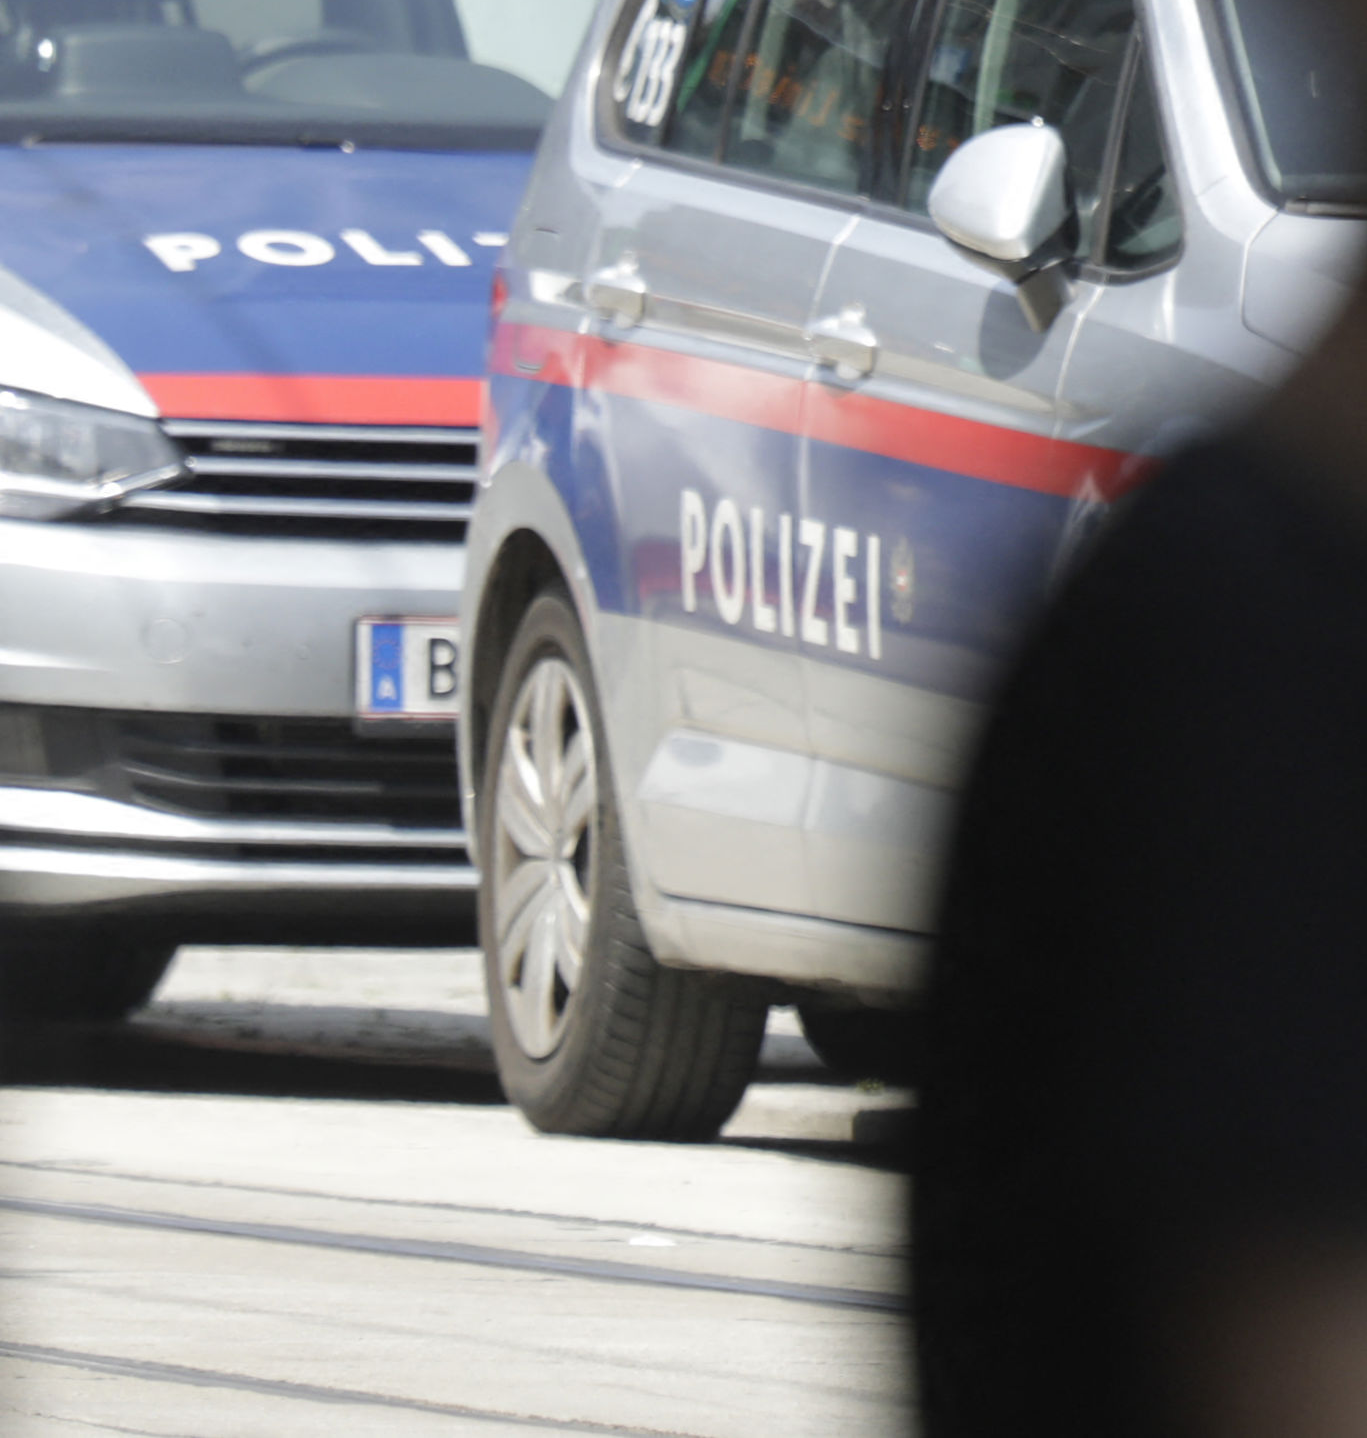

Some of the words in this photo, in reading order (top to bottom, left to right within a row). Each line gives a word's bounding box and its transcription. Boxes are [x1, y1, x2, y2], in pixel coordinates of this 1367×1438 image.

[142, 228, 510, 273] POLI
[679, 487, 883, 661] POLIZEI
[375, 675, 397, 700] A
